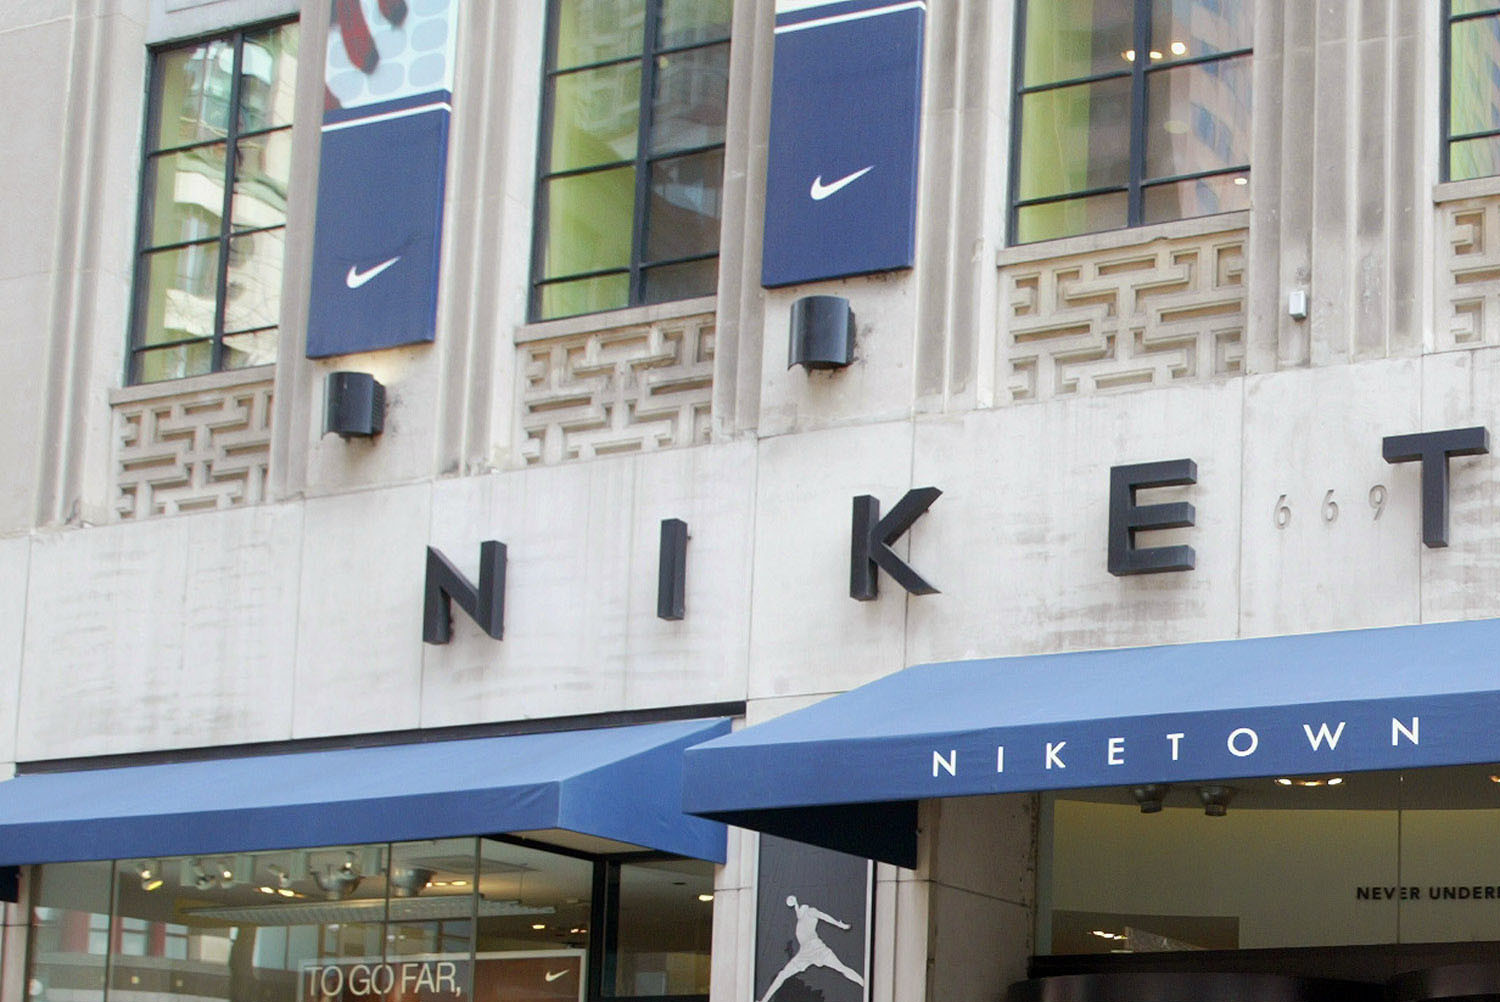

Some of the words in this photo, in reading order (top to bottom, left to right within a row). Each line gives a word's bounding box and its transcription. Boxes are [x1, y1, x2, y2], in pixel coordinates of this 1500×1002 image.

[1273, 483, 1388, 530] 669
[932, 716, 1420, 778] NIKETOWN
[1356, 886, 1421, 900] NEVER
[304, 964, 344, 997] TO
[349, 963, 394, 997] GO
[401, 961, 462, 998] FAR,
